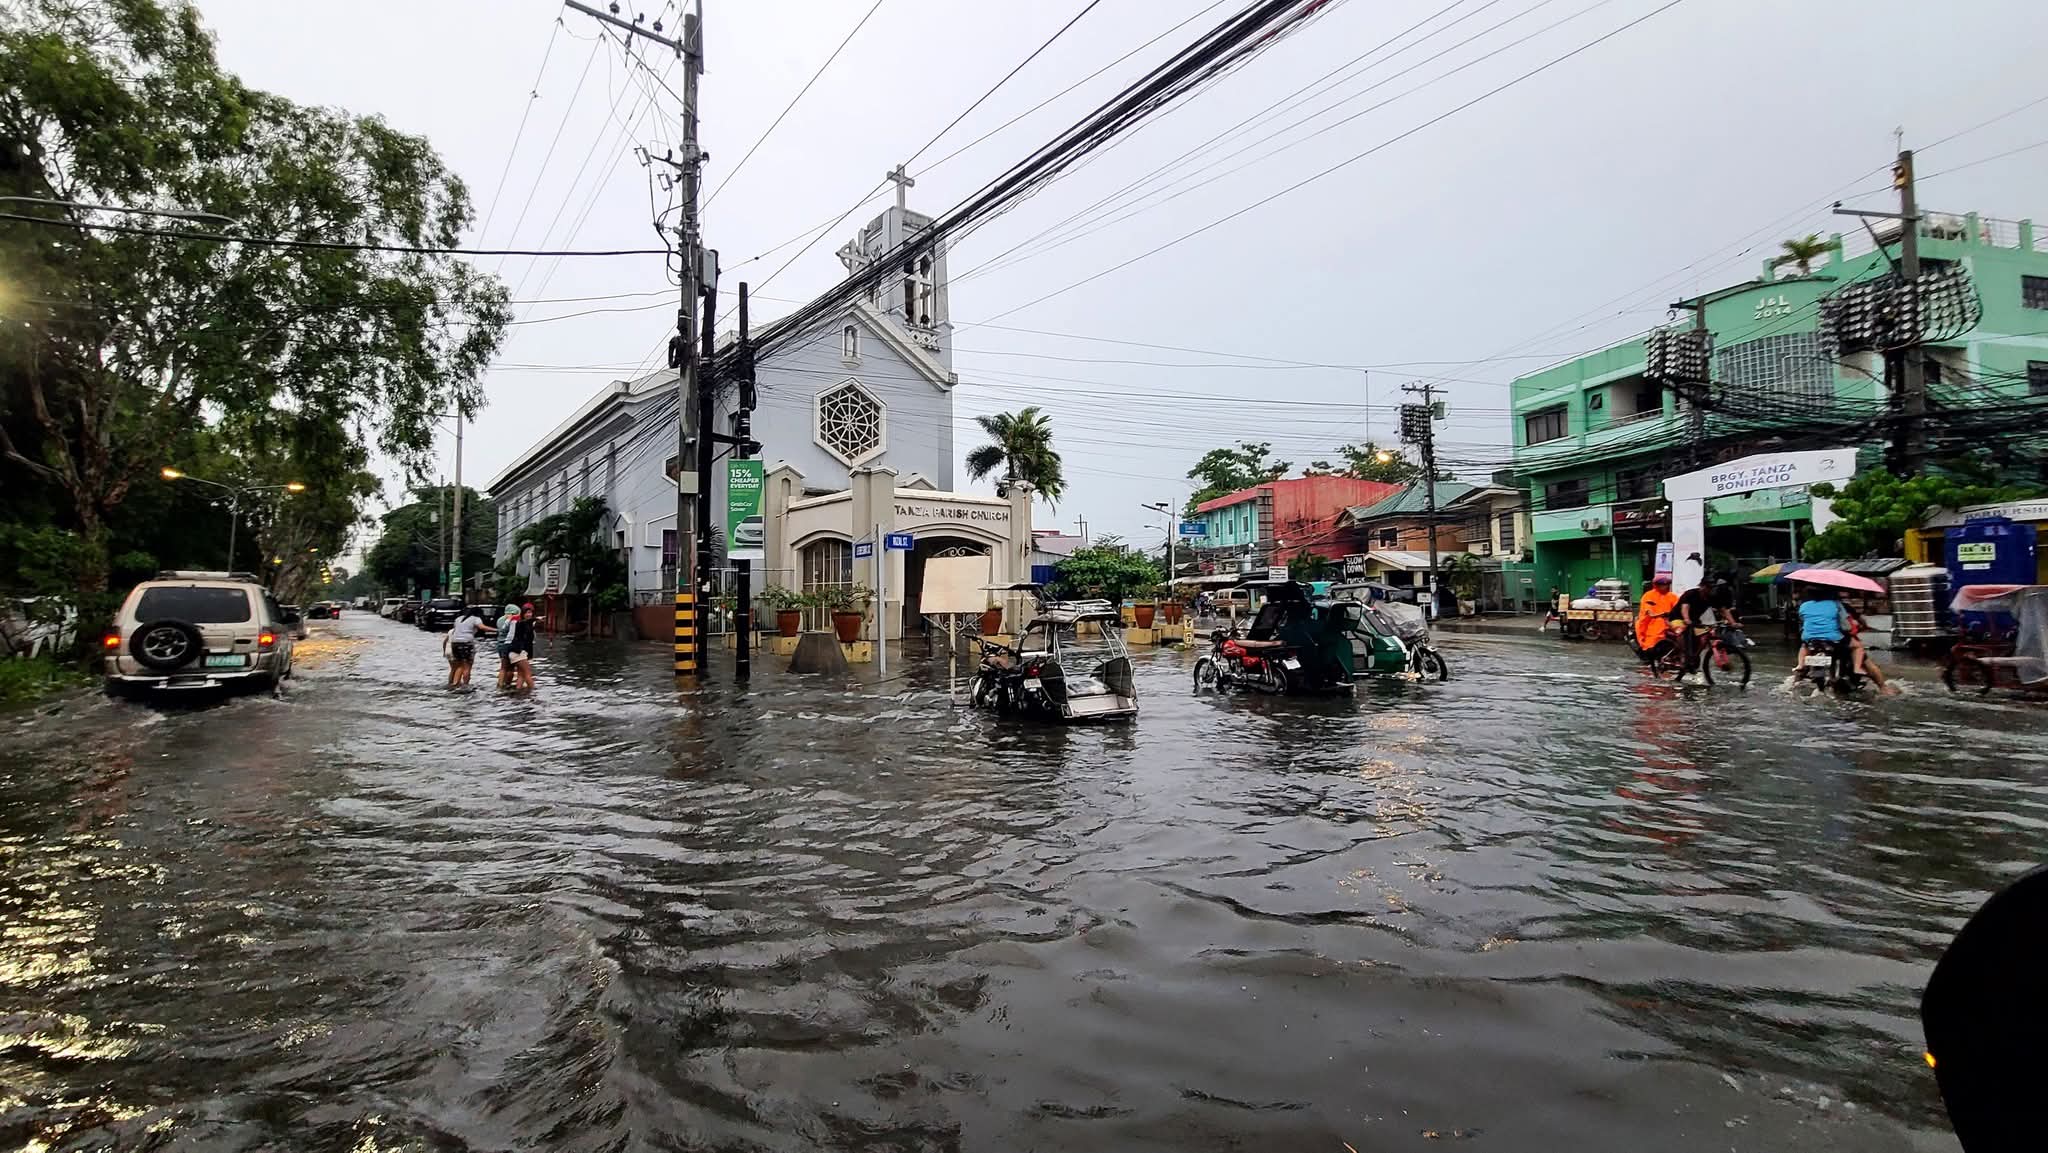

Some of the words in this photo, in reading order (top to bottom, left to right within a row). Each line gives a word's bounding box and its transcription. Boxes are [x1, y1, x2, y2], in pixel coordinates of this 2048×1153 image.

[730, 469, 752, 478] 15%
[1752, 463, 1797, 476] TANZA
[1717, 473, 1790, 491] BONIFACIO
[894, 505, 930, 517] TANZA
[933, 508, 969, 519] PARISH
[970, 510, 1009, 521] CHURCH
[1346, 556, 1363, 565] SLOW
[1347, 565, 1364, 574] DOWN
